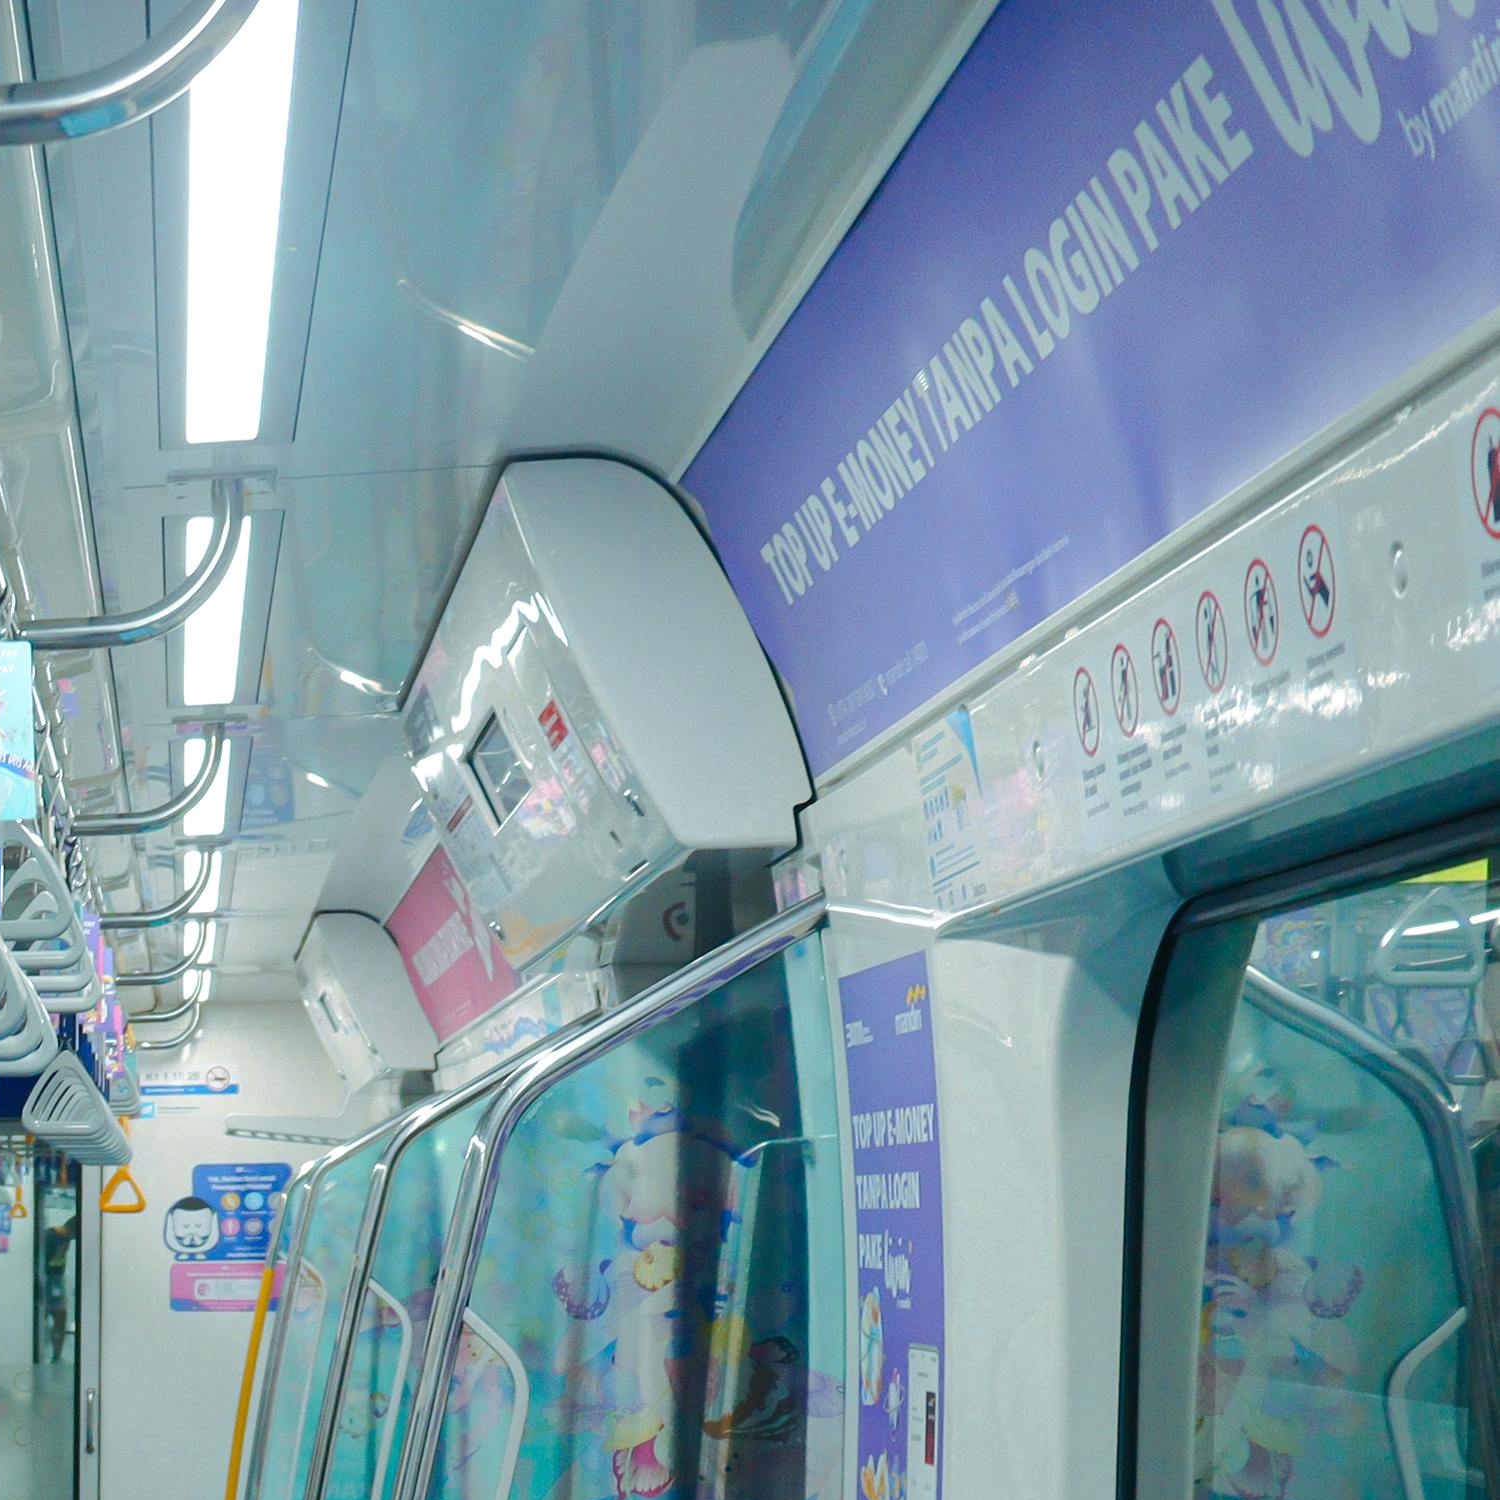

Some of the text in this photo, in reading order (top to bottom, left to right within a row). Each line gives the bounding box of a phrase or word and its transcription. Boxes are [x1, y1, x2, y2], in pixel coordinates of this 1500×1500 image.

[1398, 106, 1436, 161] by
[760, 522, 813, 606] TOP
[794, 494, 840, 573] UP
[820, 384, 936, 549] E-MONEY
[911, 296, 1035, 453] TANPA
[1002, 175, 1140, 361] LOGIN
[1107, 54, 1254, 253] PAKE
[852, 1103, 936, 1150] TOP UP E-MONEY
[856, 1171, 920, 1210] TANPA LOGIN
[859, 1233, 883, 1270] PAKE
